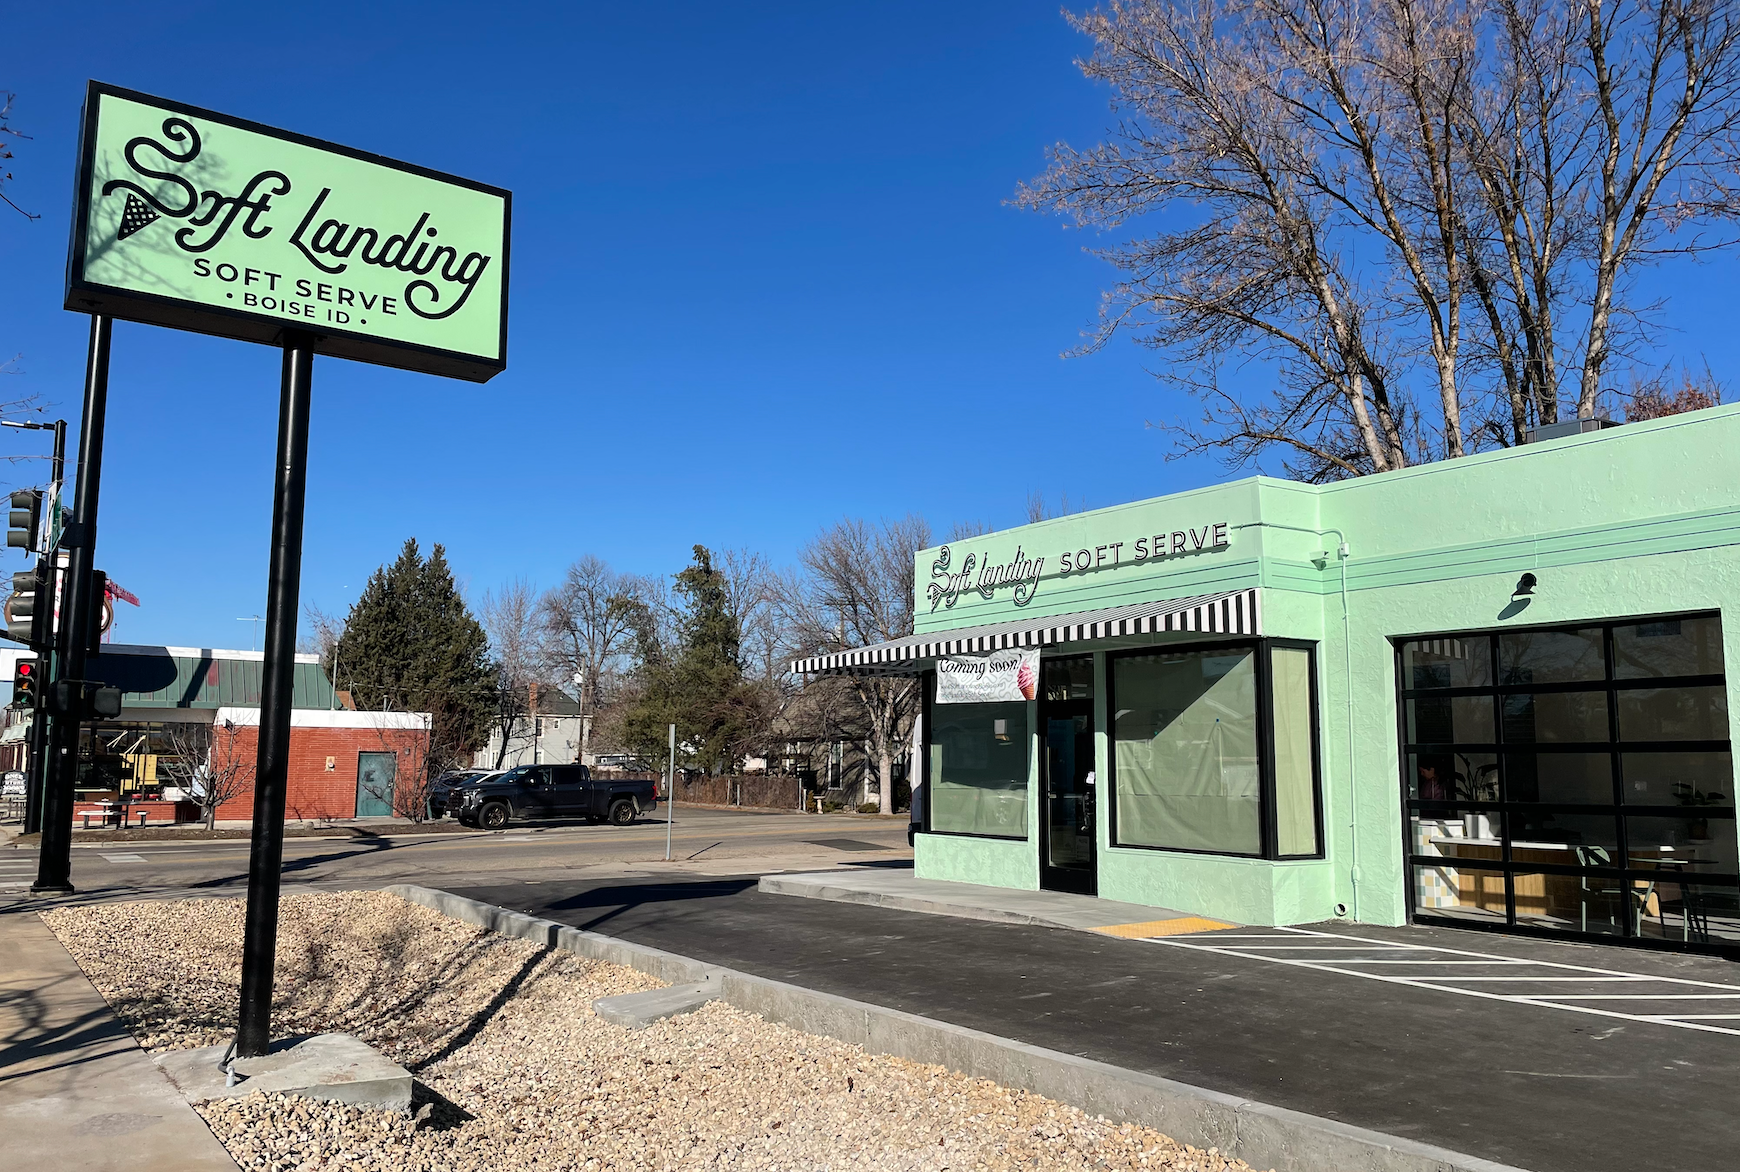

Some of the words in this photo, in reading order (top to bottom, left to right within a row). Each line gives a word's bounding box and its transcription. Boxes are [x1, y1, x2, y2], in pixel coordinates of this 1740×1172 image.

[102, 117, 291, 253] Soft
[288, 187, 491, 320] Landing
[193, 258, 282, 291] SOFT
[295, 279, 397, 316] SERVE
[243, 292, 316, 319] BOISE
[327, 309, 350, 324] ID
[926, 545, 977, 608] Soft
[976, 545, 1045, 605] Landing
[1060, 541, 1124, 574] SOFT
[1134, 522, 1229, 561] SERVE
[940, 657, 986, 680] Coming
[989, 653, 1022, 673] soon!
